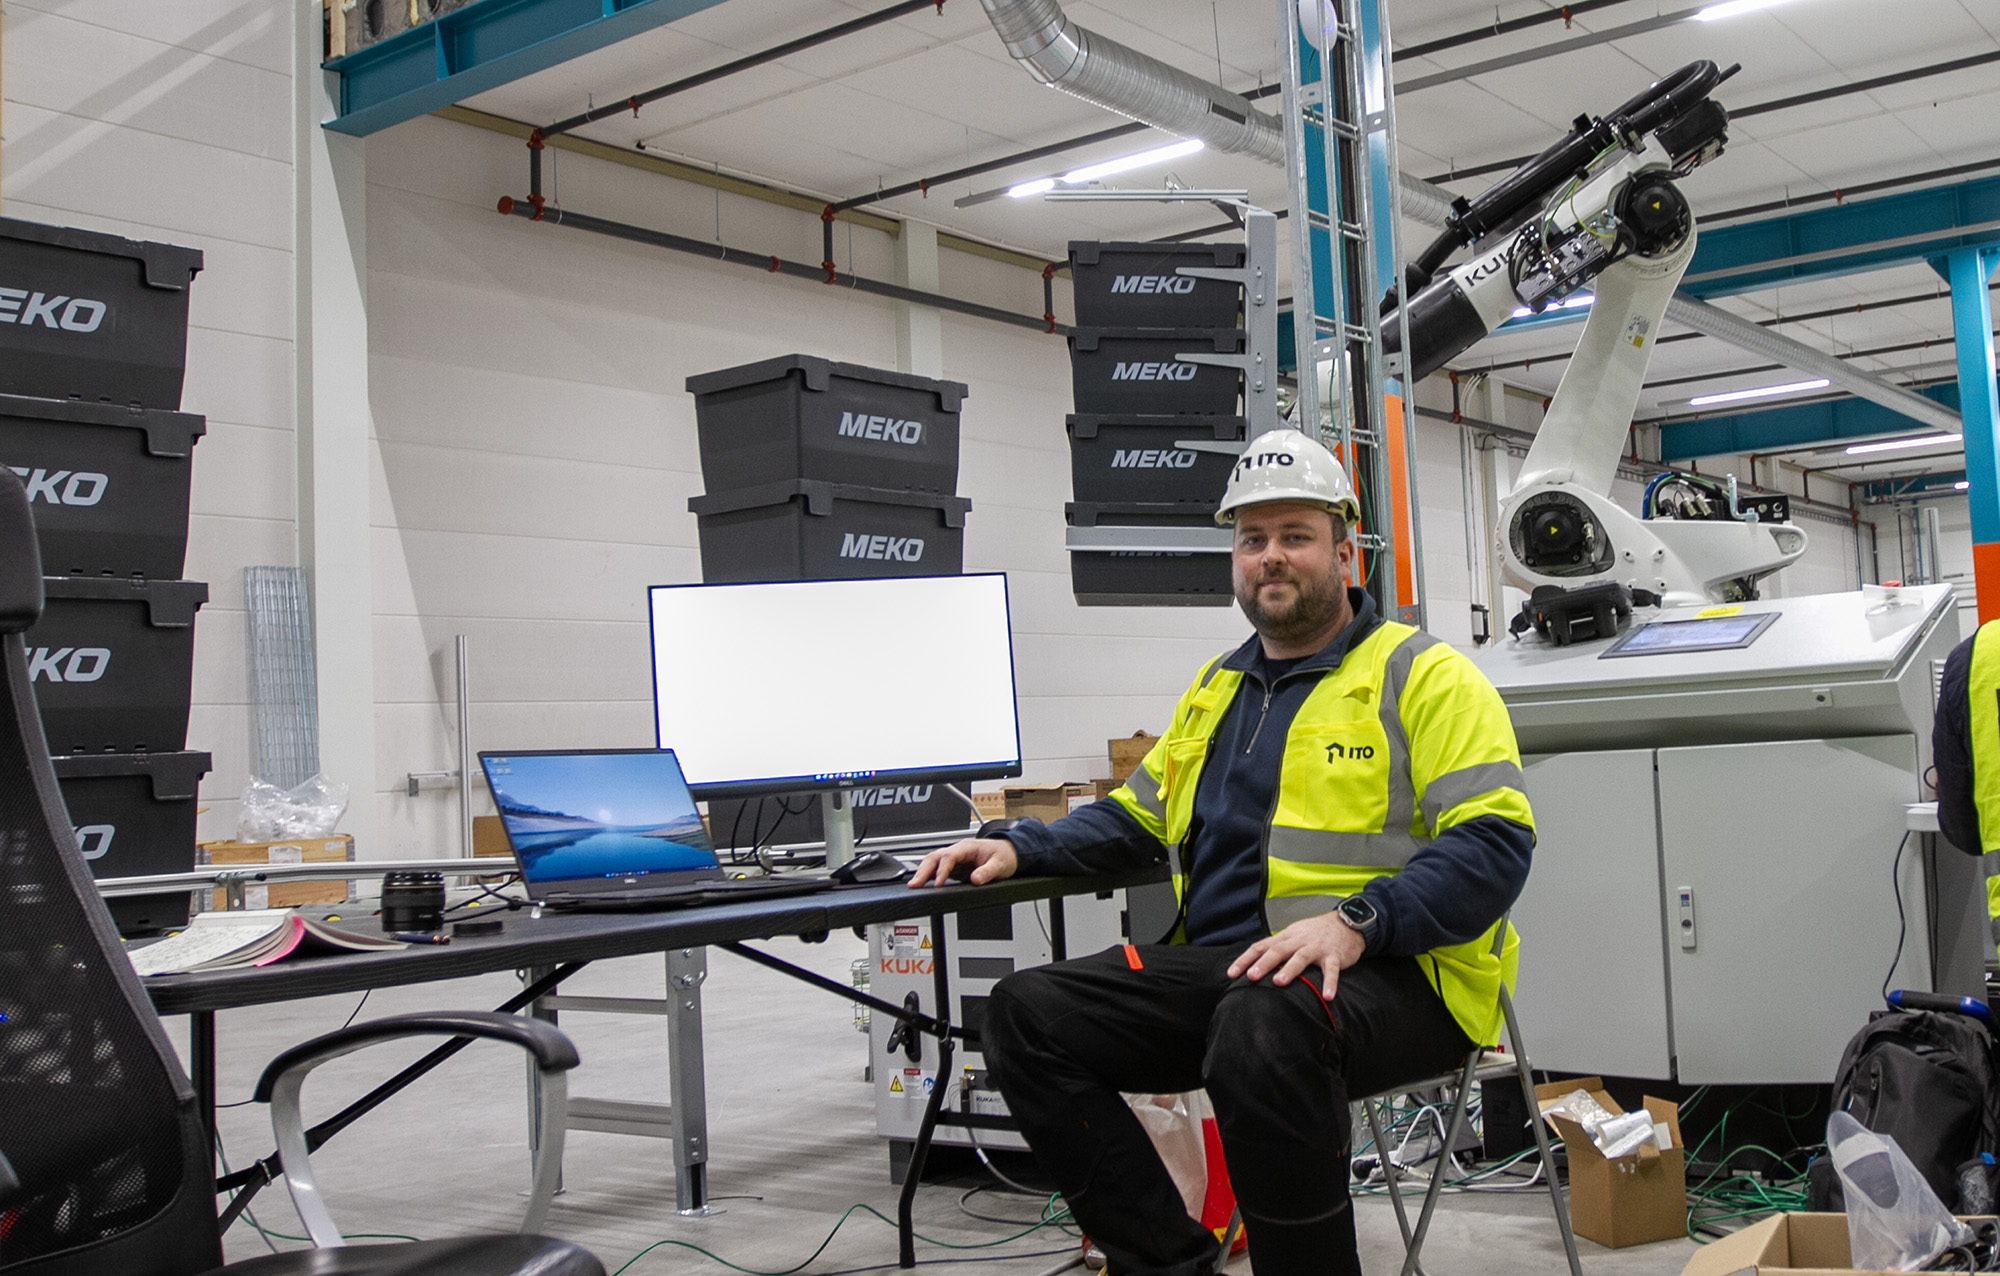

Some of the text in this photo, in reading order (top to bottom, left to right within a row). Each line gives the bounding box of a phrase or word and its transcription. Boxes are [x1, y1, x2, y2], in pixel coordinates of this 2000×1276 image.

[1465, 247, 1512, 287] KUK
[1111, 275, 1196, 294] MEKO
[1112, 362, 1198, 380] MEKO
[838, 412, 922, 445] MEKO
[1111, 449, 1198, 468] MEKO
[1257, 452, 1295, 467] ITO
[7, 466, 109, 506] KO
[840, 533, 925, 562] MEKO
[24, 647, 111, 682] KO
[1348, 745, 1375, 760] ITO
